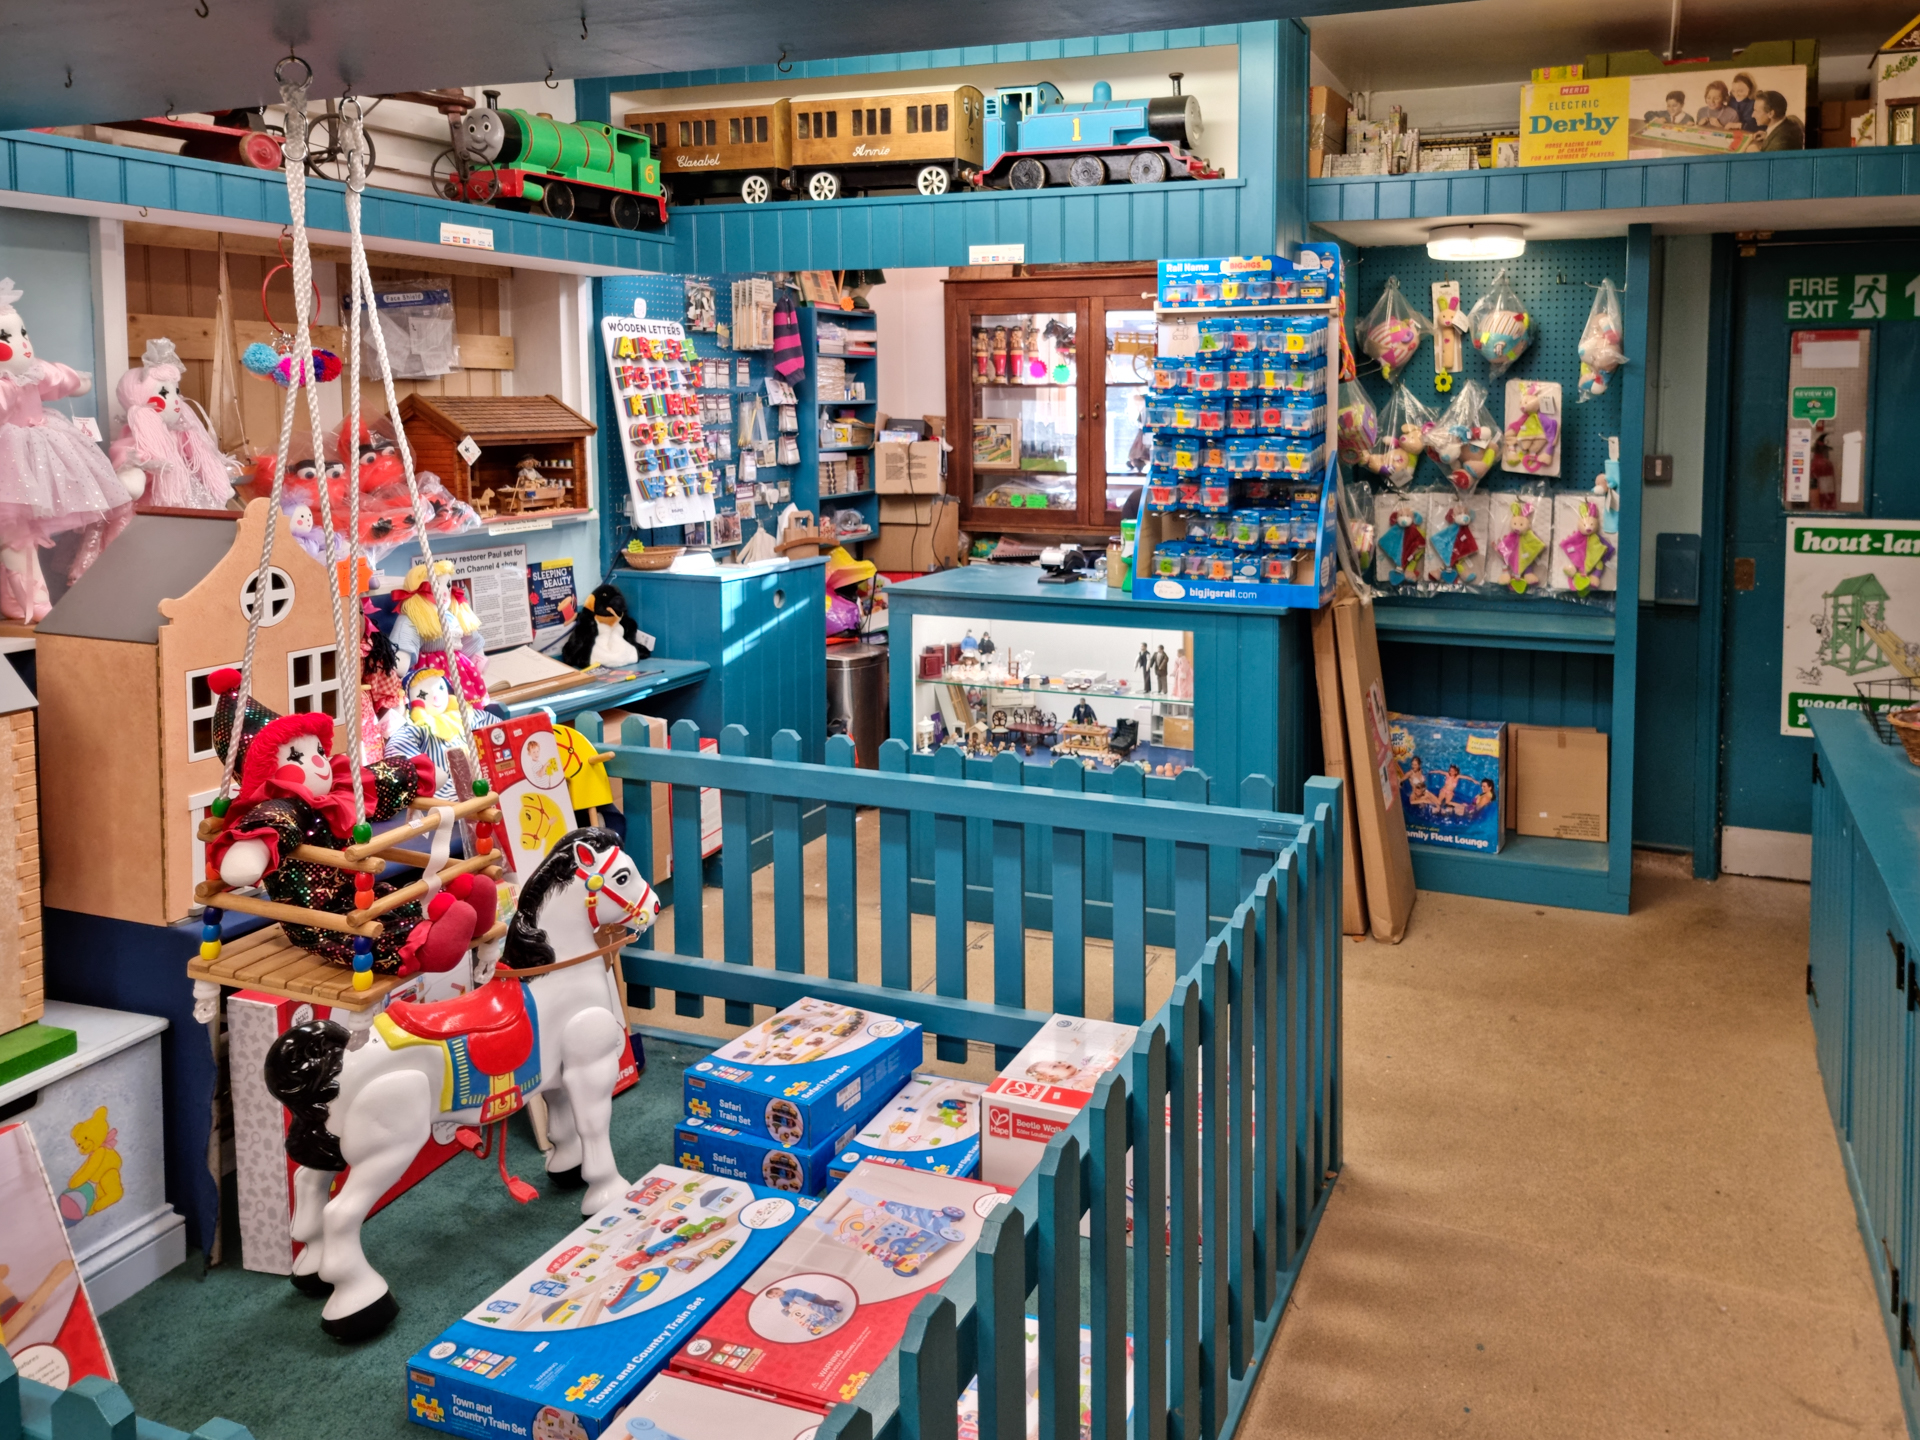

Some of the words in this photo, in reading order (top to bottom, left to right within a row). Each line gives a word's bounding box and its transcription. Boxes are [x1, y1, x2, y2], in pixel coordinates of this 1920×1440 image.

[1561, 86, 1588, 95] MERIT
[1549, 99, 1600, 111] ELECTRIC
[1072, 117, 1082, 141] 1
[1529, 112, 1619, 136] Derby
[852, 144, 890, 157] Annie
[676, 153, 720, 168] Clarabel
[645, 164, 655, 185] 6
[1166, 263, 1182, 272] Rail
[1184, 263, 1209, 272] Name
[1229, 262, 1261, 270] BIGJIGS
[1789, 277, 1838, 296] FIRE
[402, 293, 421, 301] Shield
[1788, 300, 1838, 319] EXIT
[608, 322, 646, 334] WOODEN
[648, 325, 681, 336] LETTERS
[459, 553, 486, 563] restorer
[488, 551, 501, 559] Paul
[456, 567, 465, 575] on
[467, 562, 494, 573] Channel
[533, 568, 567, 581] SLEEPING
[543, 576, 571, 588] BEAUTY
[1190, 587, 1257, 599] bigjigsrail.com
[1406, 830, 1428, 841] amily
[1431, 832, 1453, 843] Float
[1455, 836, 1488, 848] Lounge
[801, 1083, 822, 1099] Safari
[820, 1072, 840, 1087] Train
[719, 1099, 742, 1112] Safari
[719, 1110, 737, 1122] Train
[740, 1115, 751, 1126] Set
[990, 1125, 1009, 1136] Hape
[1016, 1119, 1041, 1131] Beetle
[1043, 1123, 1064, 1133] Walk
[713, 1153, 737, 1166] Safari
[713, 1163, 732, 1176] Train
[733, 1169, 747, 1180] Set
[588, 1380, 618, 1405] Town
[616, 1363, 635, 1382] and
[632, 1330, 672, 1364] Country
[666, 1310, 690, 1331] Train
[686, 1296, 705, 1312] Set
[818, 1349, 844, 1378] WARNING
[535, 1362, 559, 1382] WARNING
[452, 1394, 476, 1408] Town
[476, 1402, 492, 1415] and
[452, 1406, 487, 1426] Country
[489, 1417, 511, 1432] Train
[511, 1424, 527, 1437] Set
